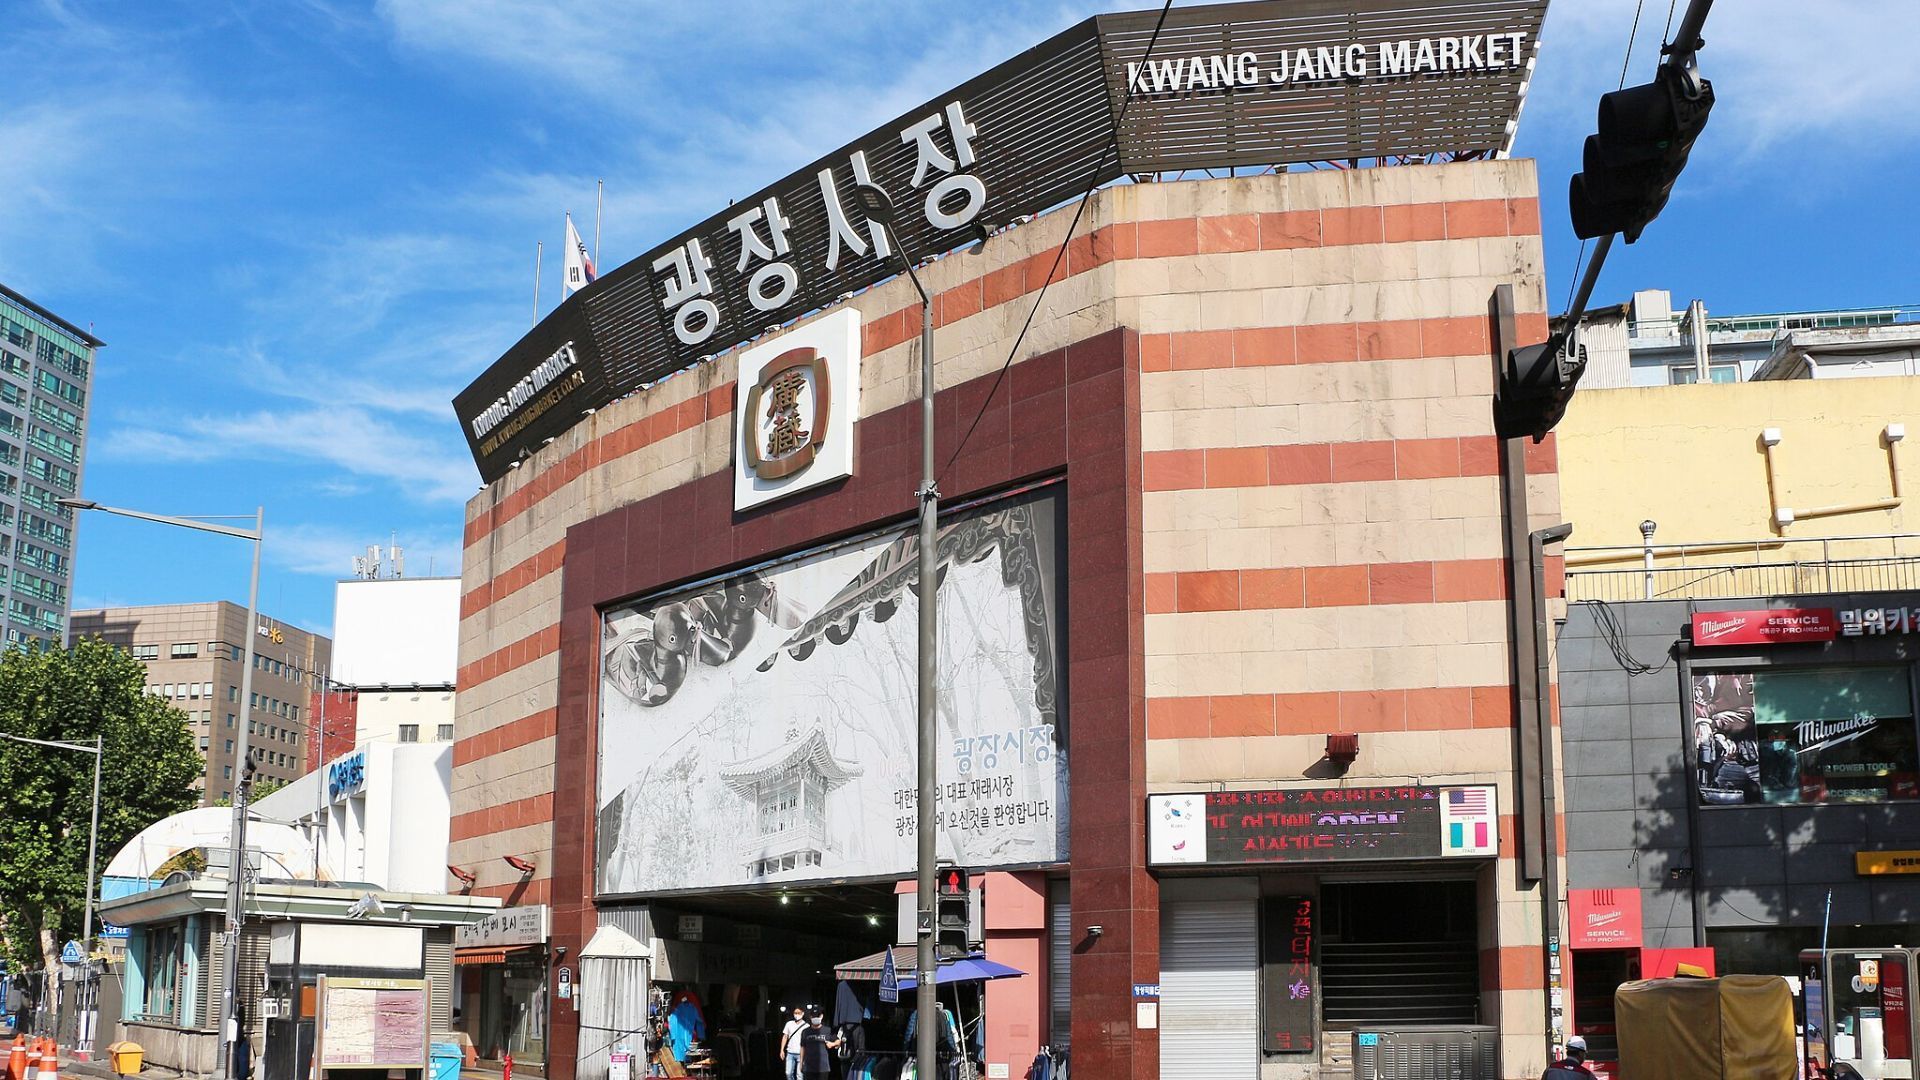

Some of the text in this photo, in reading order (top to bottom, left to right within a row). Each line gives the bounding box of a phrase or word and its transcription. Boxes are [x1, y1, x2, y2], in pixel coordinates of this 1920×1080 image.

[1127, 31, 1528, 94] KWANG JANG MARKET
[652, 100, 986, 345] 광장시장
[530, 340, 577, 392] MARKET
[1699, 616, 1820, 636] Milwaukee SERVICE
[1840, 607, 1910, 636] 밀워키
[1792, 713, 1878, 746] Milwaukee
[952, 723, 1056, 774] 광장시장
[1833, 763, 1865, 773] POWER
[1866, 762, 1896, 772] TOOLS
[946, 782, 967, 803] 대표
[969, 774, 1014, 801] 재래시장
[948, 808, 990, 836] 오신것을
[993, 800, 1053, 827] 환영합니다.
